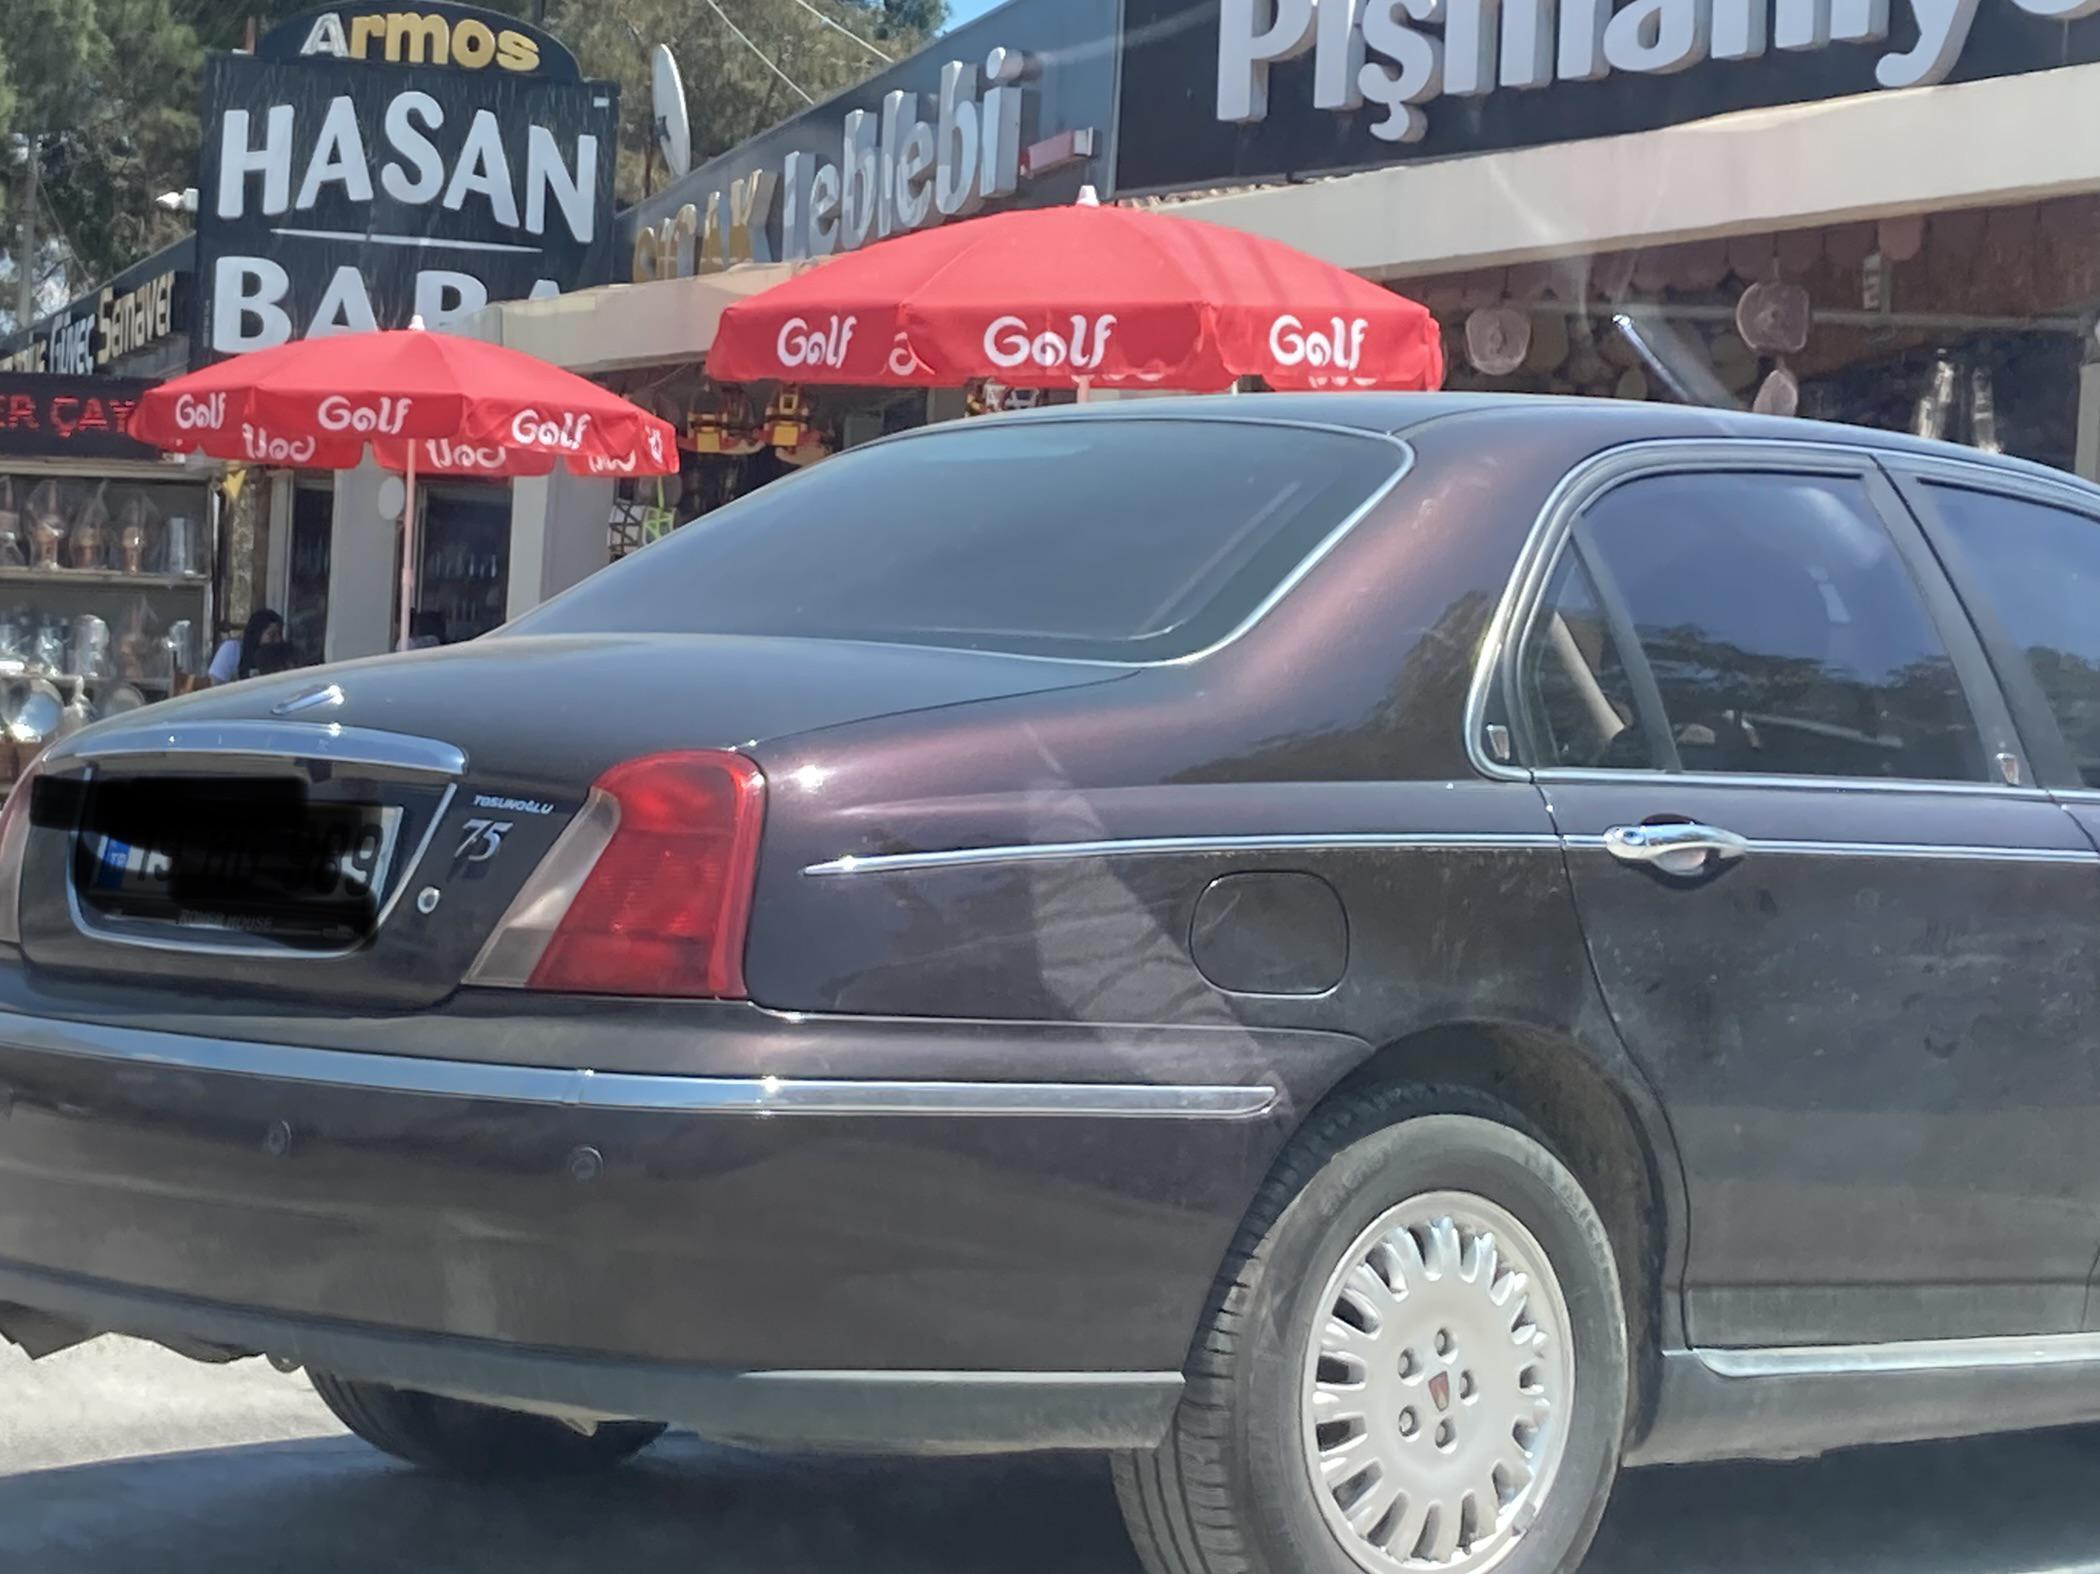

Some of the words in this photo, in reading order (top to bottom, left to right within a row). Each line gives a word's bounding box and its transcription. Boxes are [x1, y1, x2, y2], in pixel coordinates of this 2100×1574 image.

[300, 11, 541, 73] Armos
[217, 91, 599, 244] HASAN
[213, 256, 562, 353] BAB
[776, 315, 858, 369] Golf
[982, 313, 1118, 369] Golf
[1269, 314, 1369, 371] Golf
[175, 392, 227, 430] Golf
[317, 395, 413, 435] Golf
[511, 408, 592, 450] Golf
[454, 819, 514, 862] 75
